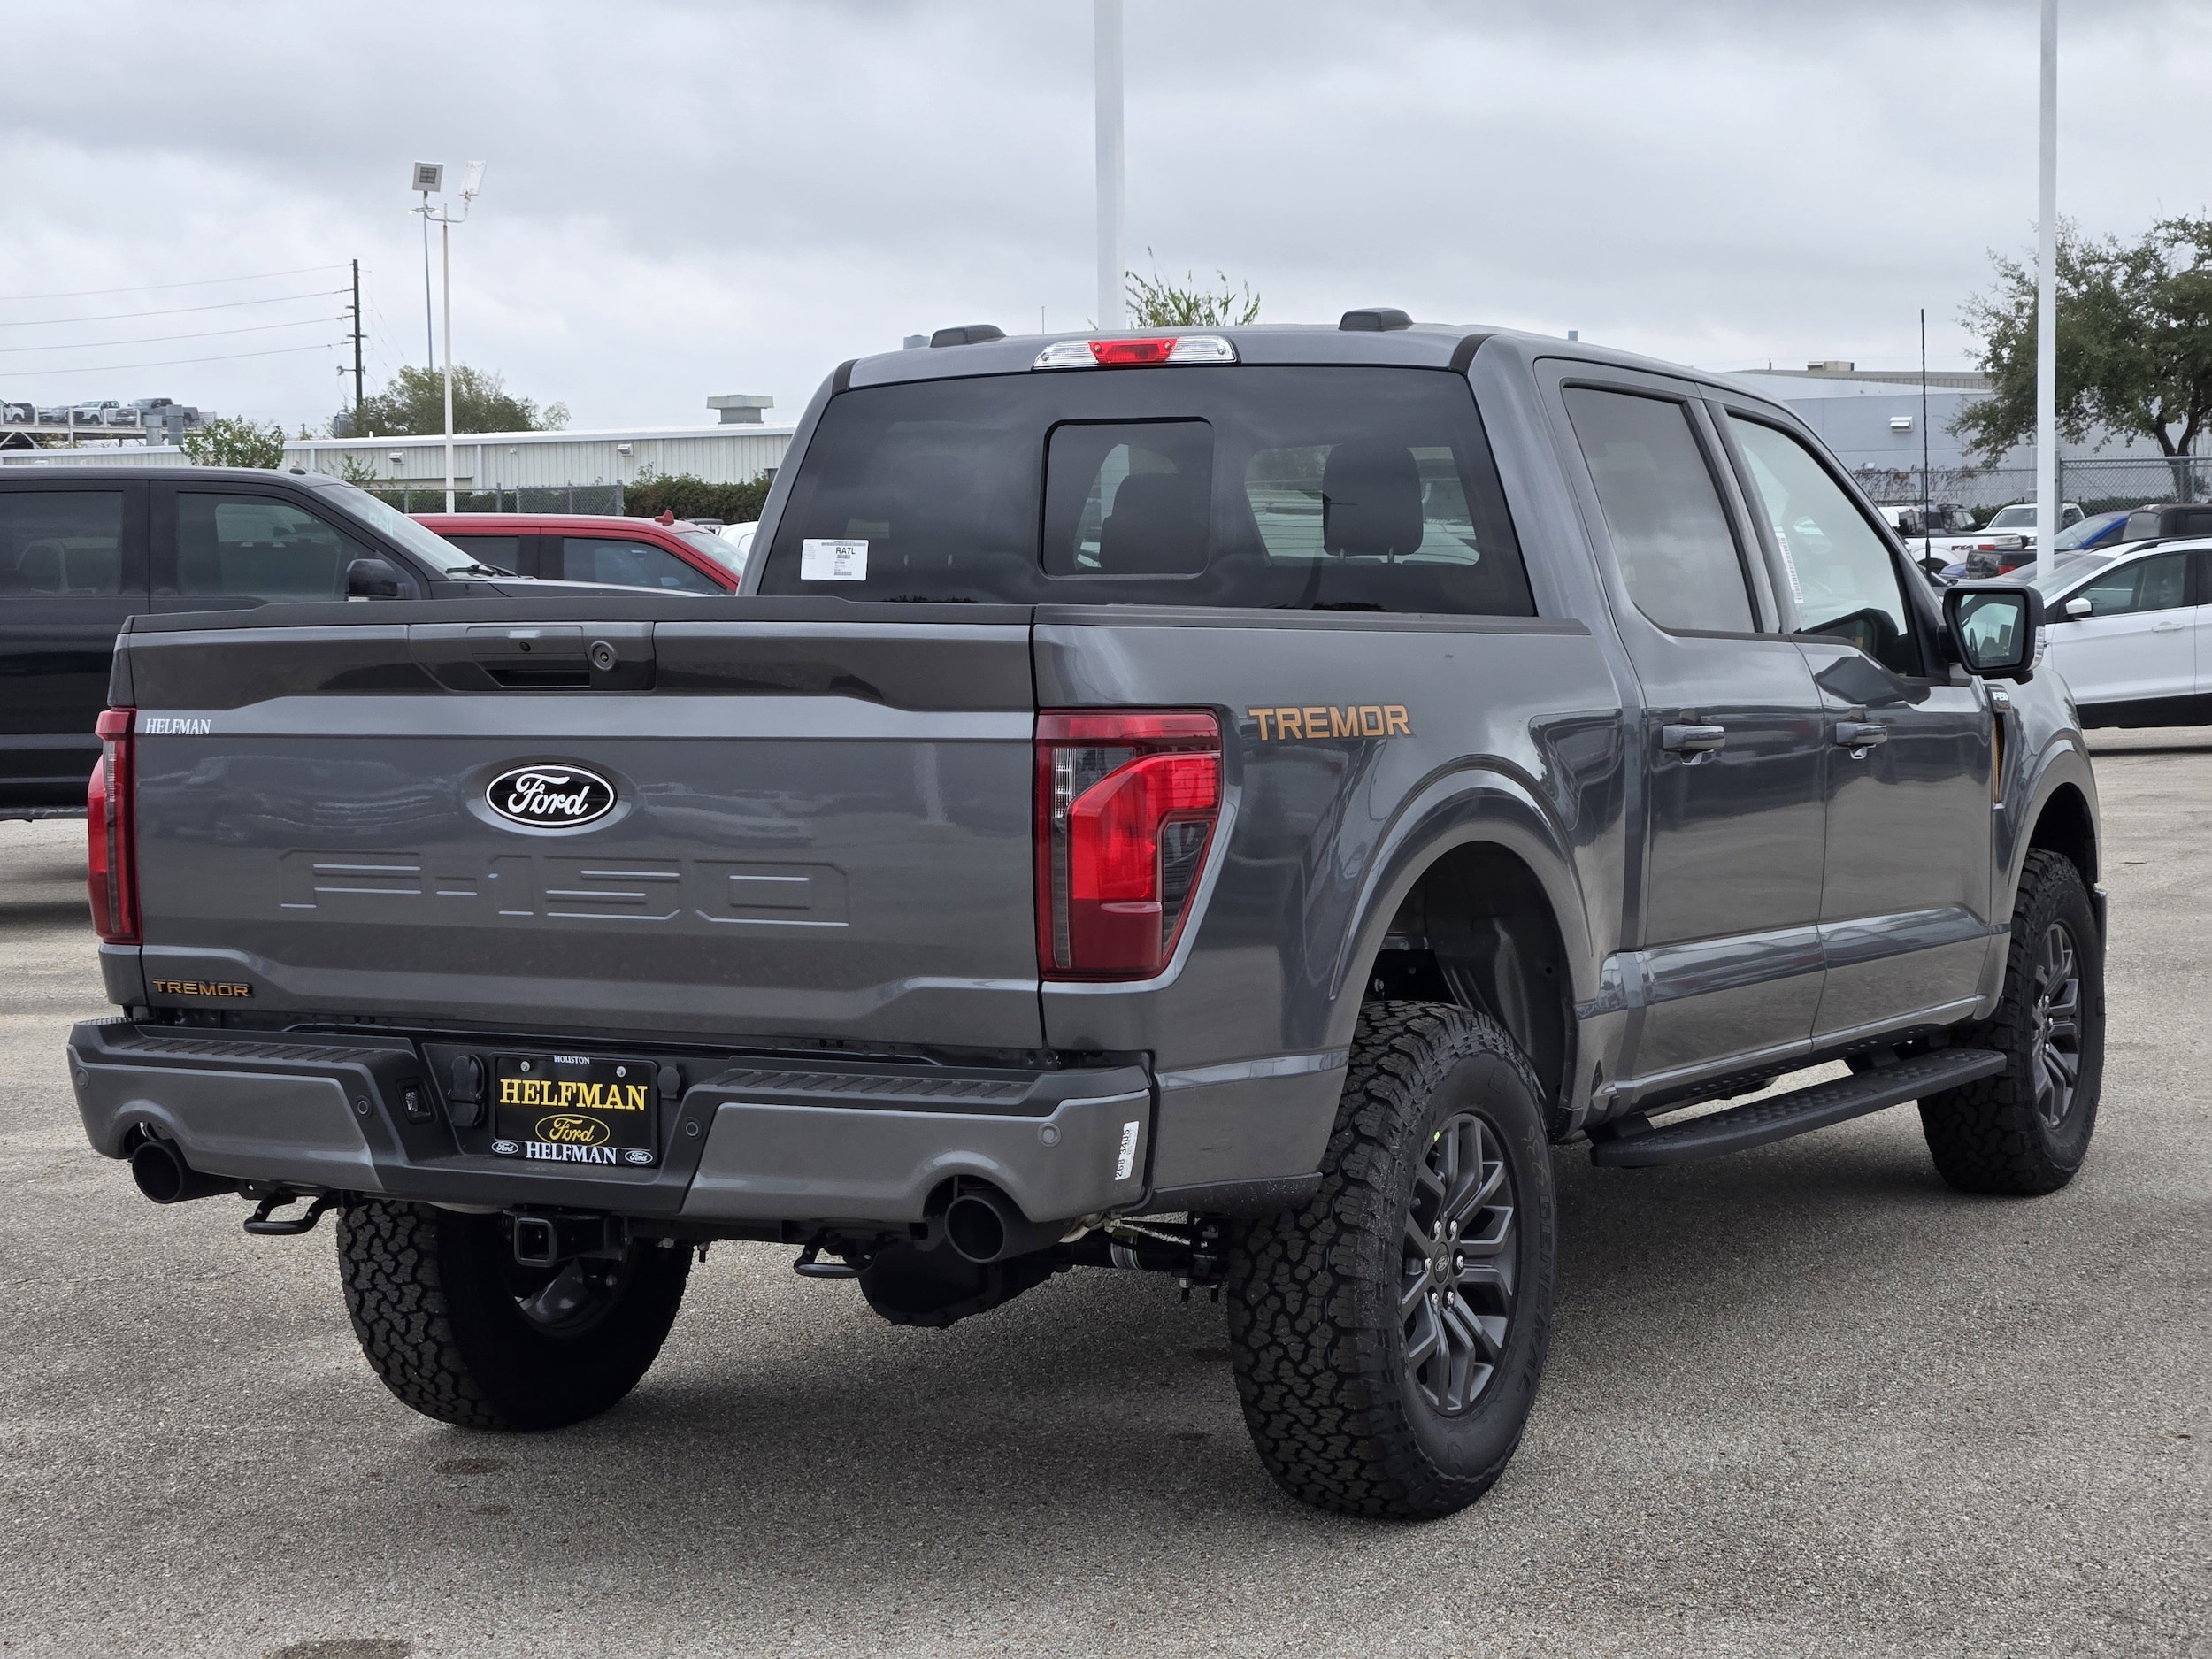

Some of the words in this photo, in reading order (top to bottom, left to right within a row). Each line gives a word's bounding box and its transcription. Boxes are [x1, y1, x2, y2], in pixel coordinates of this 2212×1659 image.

[145, 718, 212, 735] HELFMAN
[1248, 705, 1412, 741] TREMOR
[507, 773, 591, 816] Ford
[280, 849, 849, 927] F-150
[151, 979, 250, 997] TREMOR
[553, 1055, 591, 1065] HOUSTON
[499, 1079, 649, 1111] HELFMAN
[549, 1117, 595, 1143] Ford
[526, 1141, 618, 1165] HELFMAN
[1517, 1194, 1554, 1393] GENERAL
